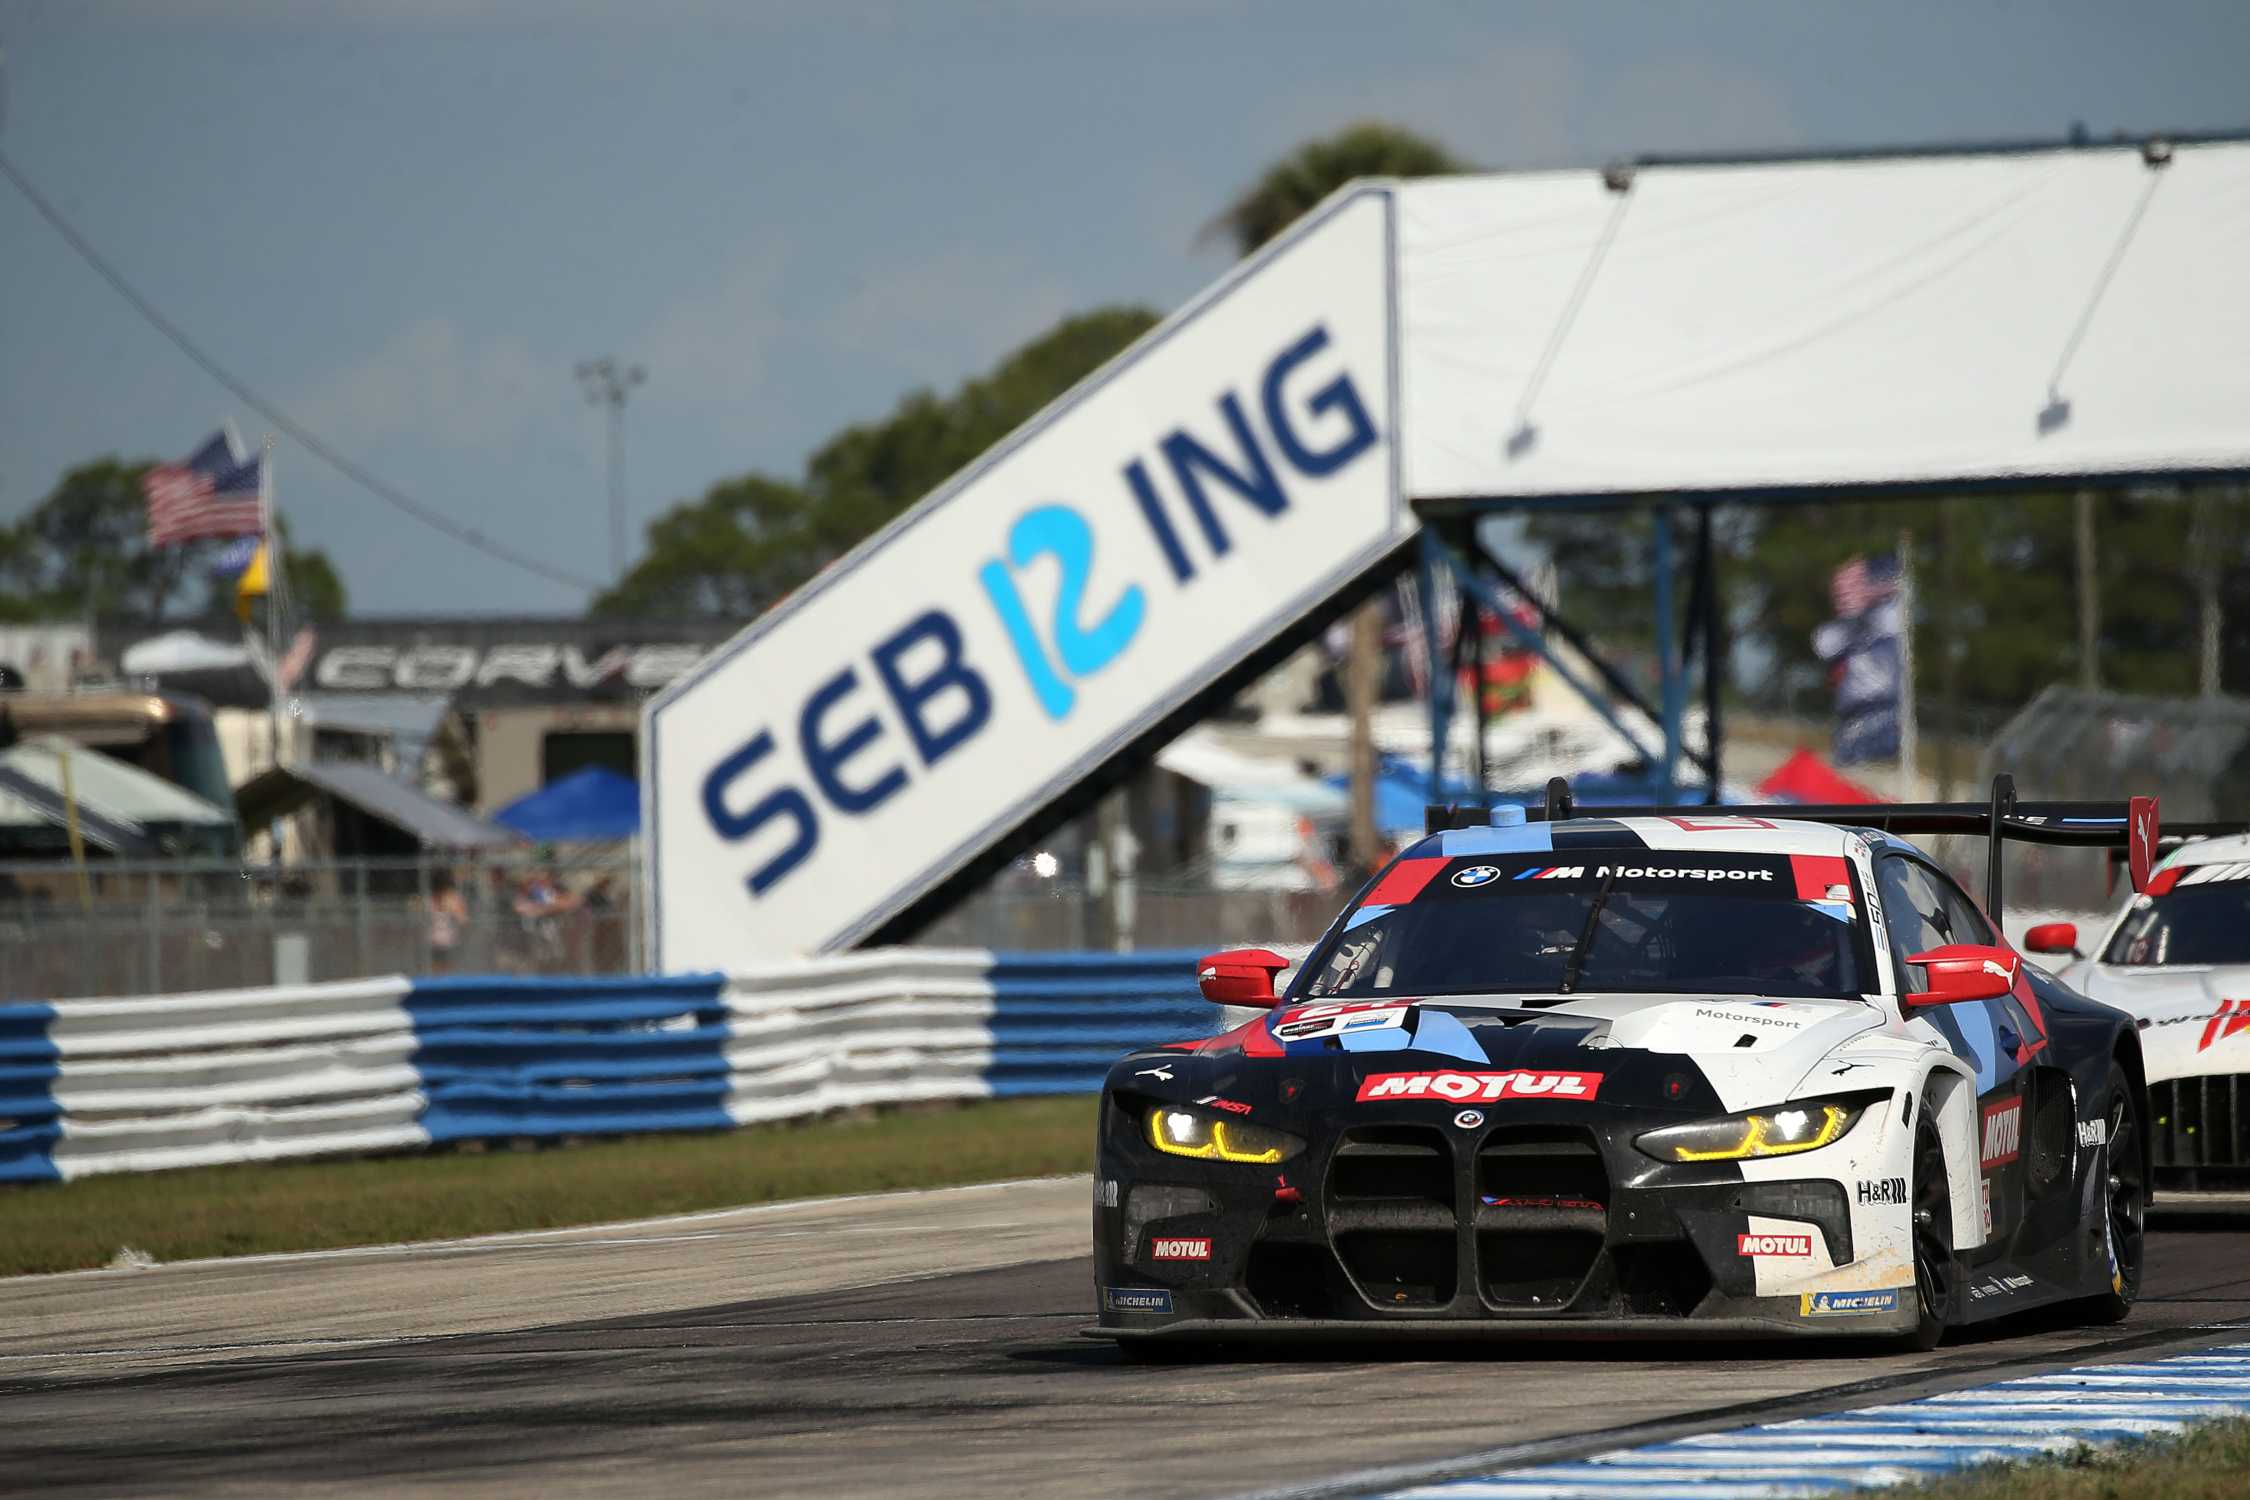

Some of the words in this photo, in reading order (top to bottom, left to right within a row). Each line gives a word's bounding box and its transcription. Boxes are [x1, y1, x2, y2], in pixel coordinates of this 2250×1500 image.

[1596, 866, 1774, 881] Motorsport
[1696, 1008, 1801, 1029] Motorsport
[1367, 1072, 1587, 1098] MOTUL
[1982, 1107, 2020, 1162] MOTUL
[1857, 1179, 1895, 1205] H&R
[1155, 1241, 1208, 1257] MOTUL
[1742, 1238, 1809, 1254] MOTUL
[1115, 1296, 1164, 1307] MICHELIN
[1832, 1296, 1893, 1309] MICHELIN
